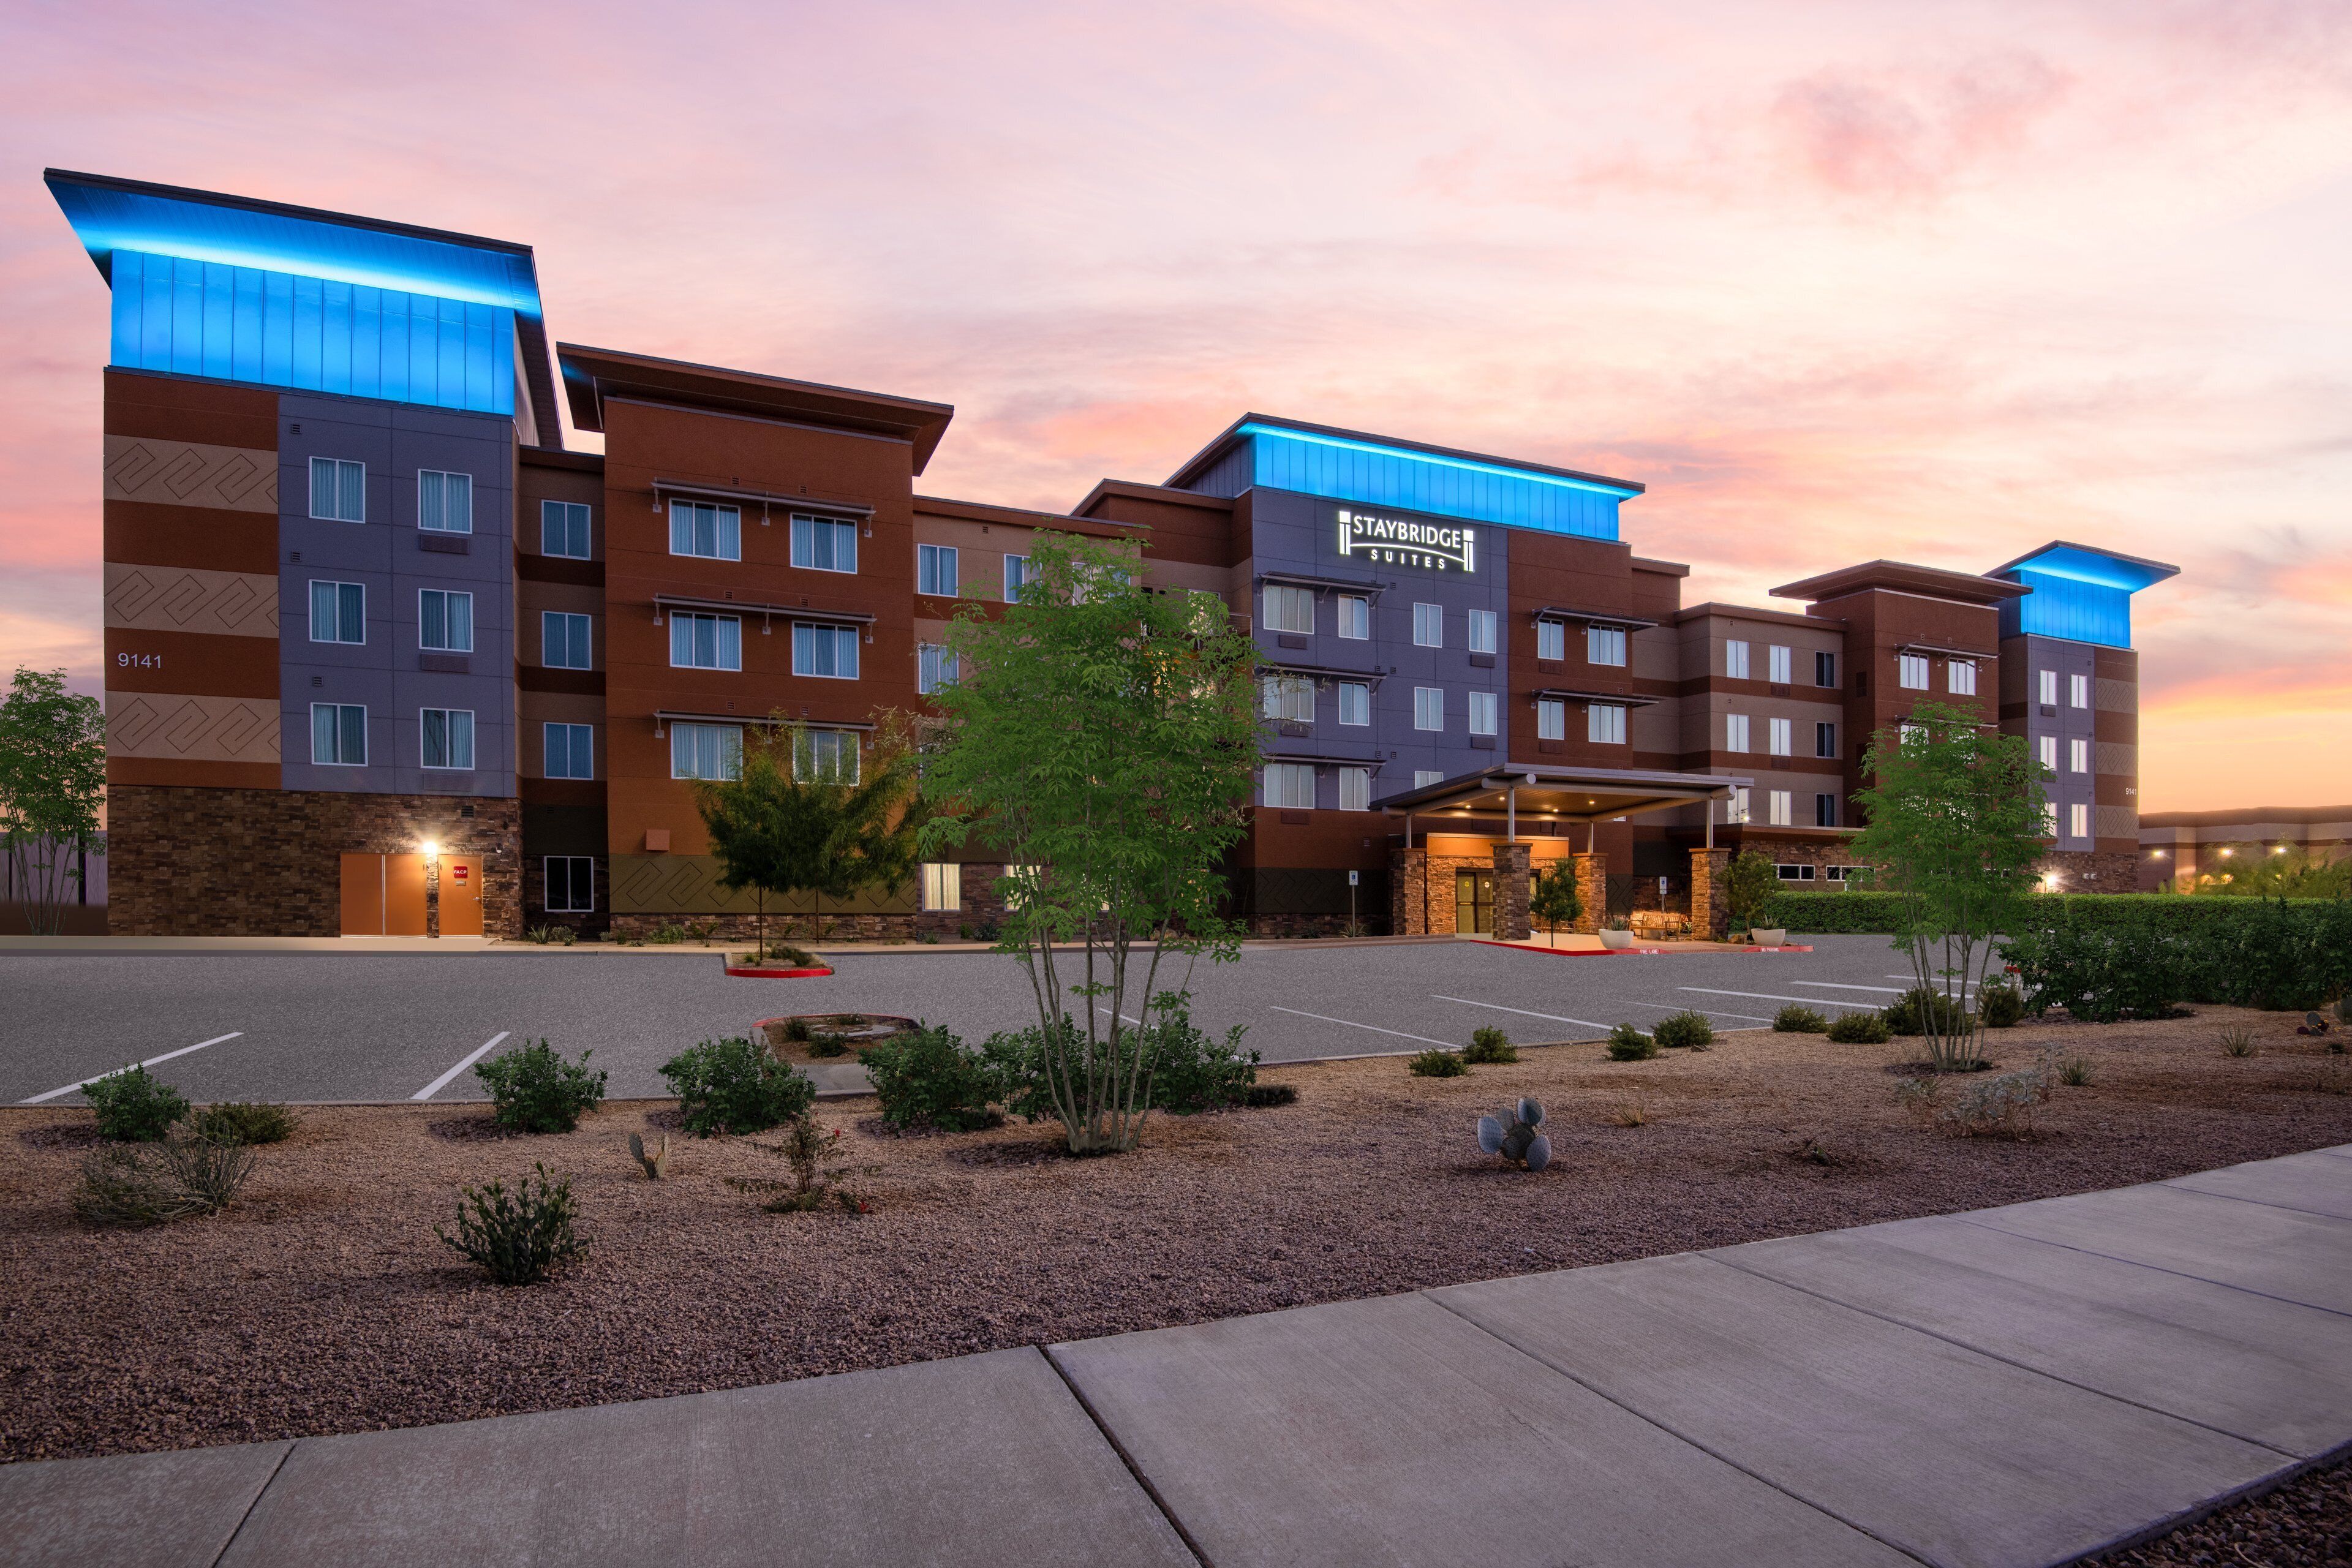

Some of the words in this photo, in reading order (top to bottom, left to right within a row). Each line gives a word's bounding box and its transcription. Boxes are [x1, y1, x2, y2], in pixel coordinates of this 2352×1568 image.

[1353, 515, 1461, 548] STAYBRIDGE
[1371, 549, 1445, 569] SUITES
[118, 652, 160, 669] 9141
